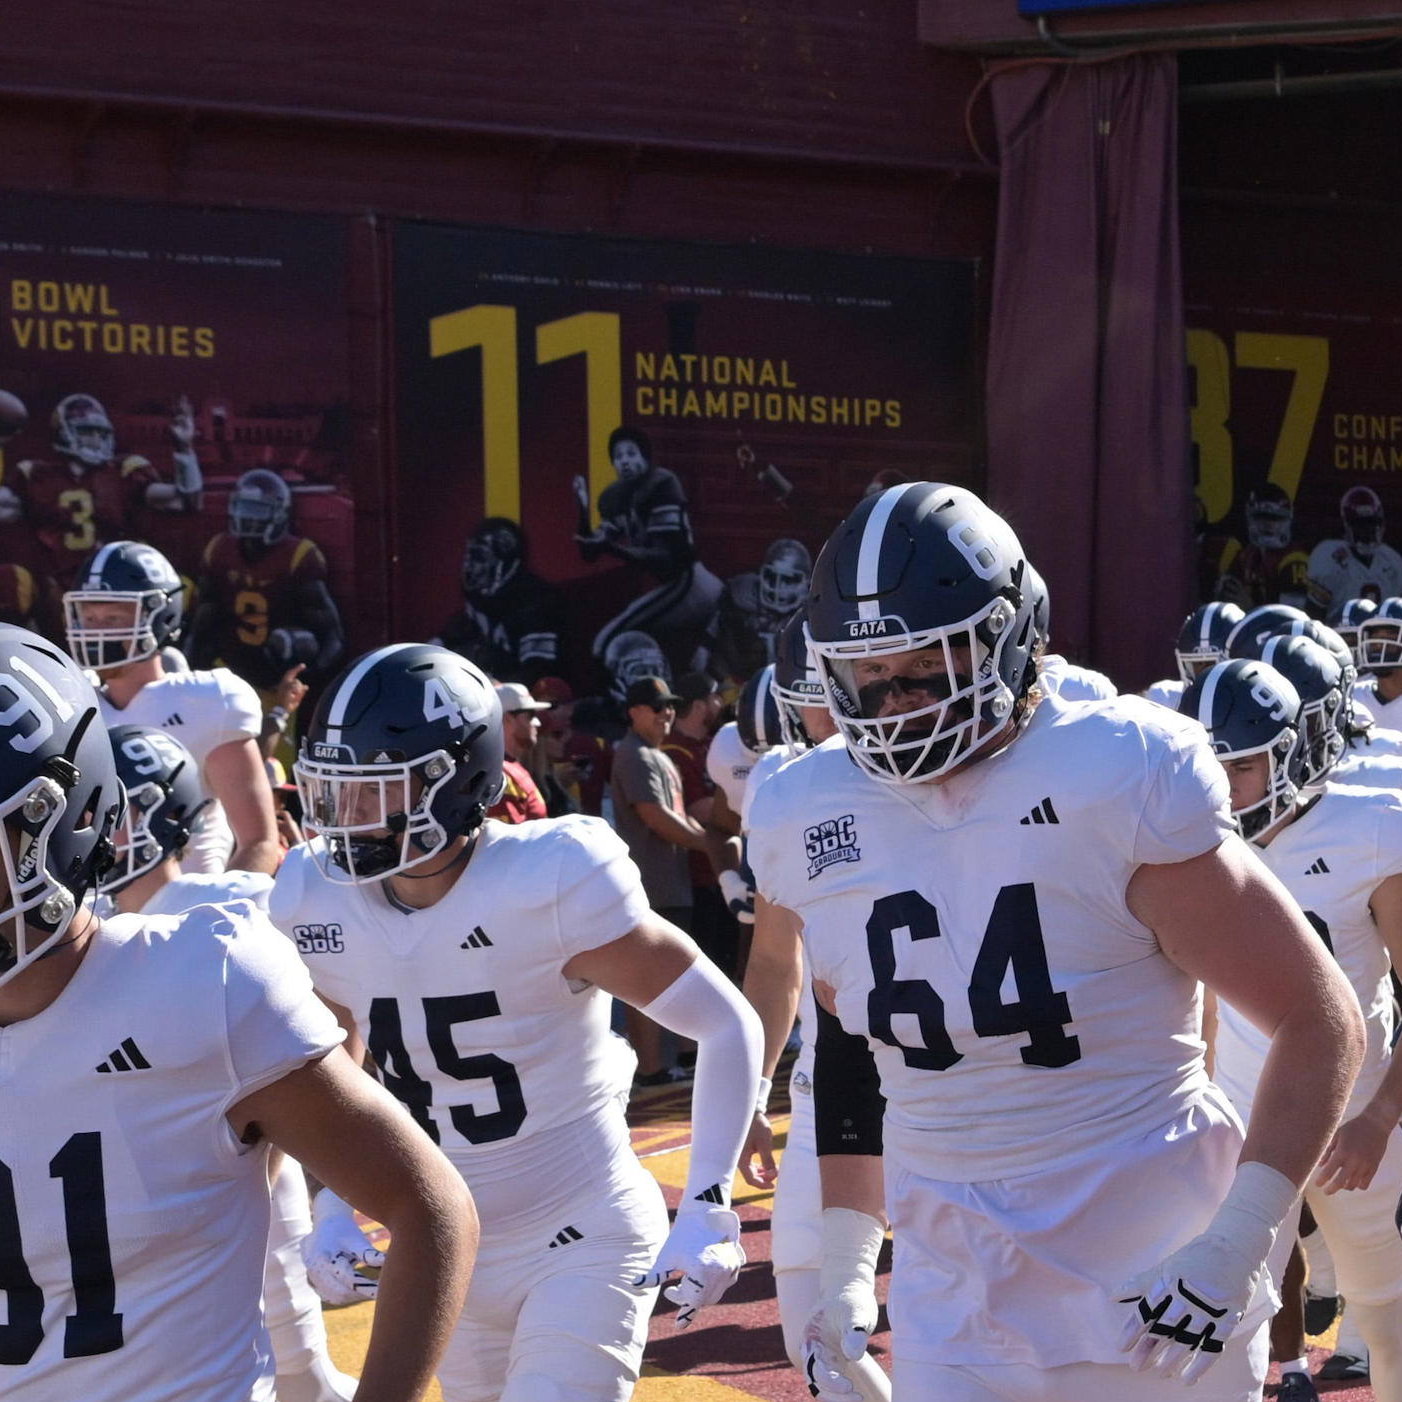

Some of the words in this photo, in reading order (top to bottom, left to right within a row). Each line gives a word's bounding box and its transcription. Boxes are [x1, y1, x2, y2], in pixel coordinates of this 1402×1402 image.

[12, 279, 118, 316] BOWL
[12, 319, 216, 358] VICTORIES
[635, 352, 797, 388] NATIONAL
[429, 304, 623, 528] 11
[635, 386, 902, 428] CHAMPIONSHIPS
[58, 490, 97, 551] 3
[850, 620, 886, 637] GATA
[799, 684, 823, 694] GATA
[314, 746, 339, 759] GATA
[804, 814, 857, 860] SBC
[813, 848, 853, 869] GRADUATE
[292, 922, 344, 955] SBC
[866, 881, 1082, 1072] 64
[367, 990, 528, 1146] 45
